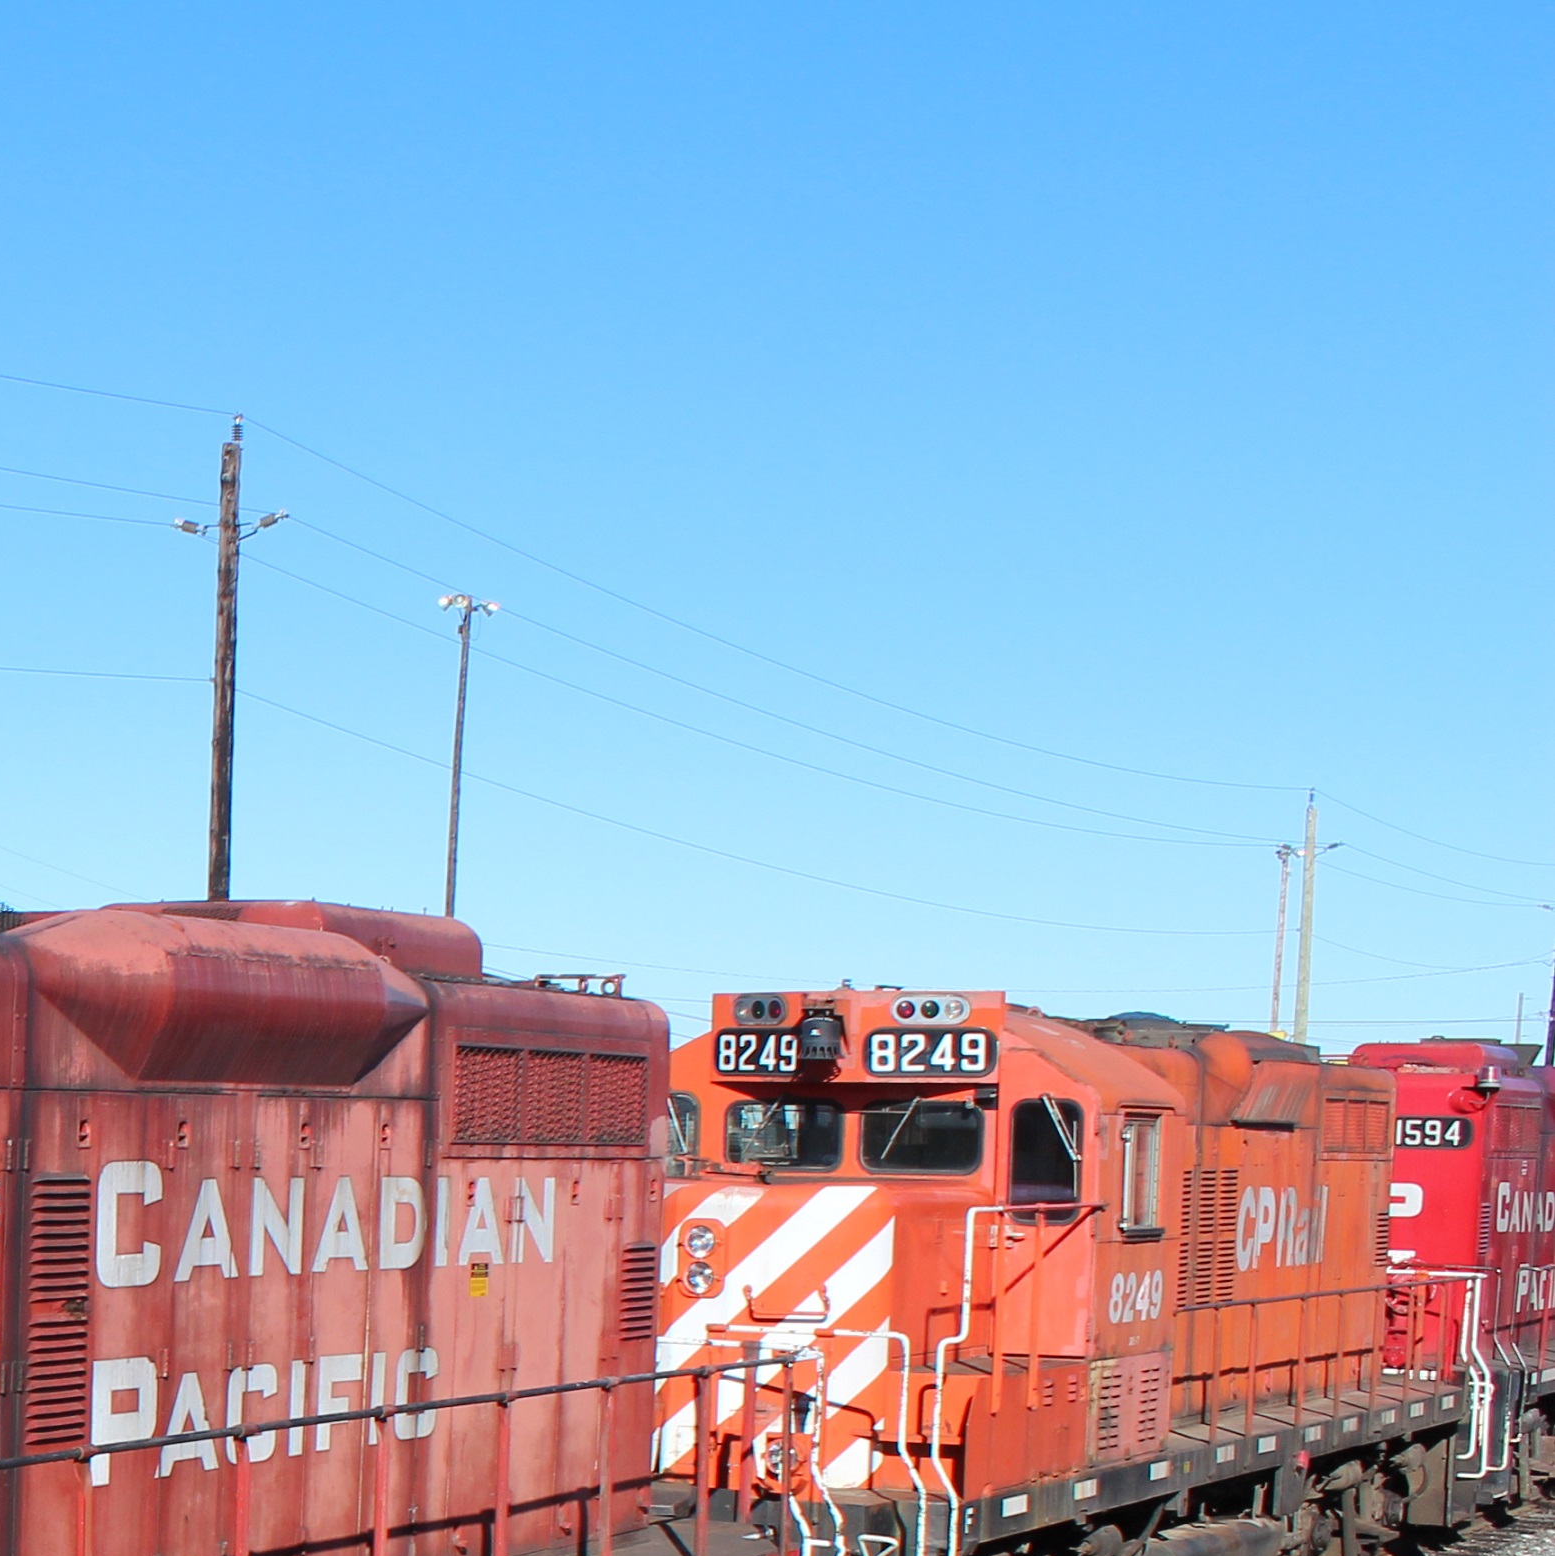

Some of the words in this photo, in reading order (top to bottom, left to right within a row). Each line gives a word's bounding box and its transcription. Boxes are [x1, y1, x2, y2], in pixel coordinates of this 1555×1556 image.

[718, 1033, 798, 1072] 8249
[869, 1033, 987, 1072] 8249
[1395, 1119, 1461, 1146] 1594
[95, 1160, 556, 1288] CANADIAN
[1235, 1185, 1276, 1272] CP
[1275, 1184, 1329, 1268] Rail
[1109, 1269, 1163, 1325] 8249
[89, 1345, 440, 1488] PACIFIC
[964, 1507, 975, 1534] F
